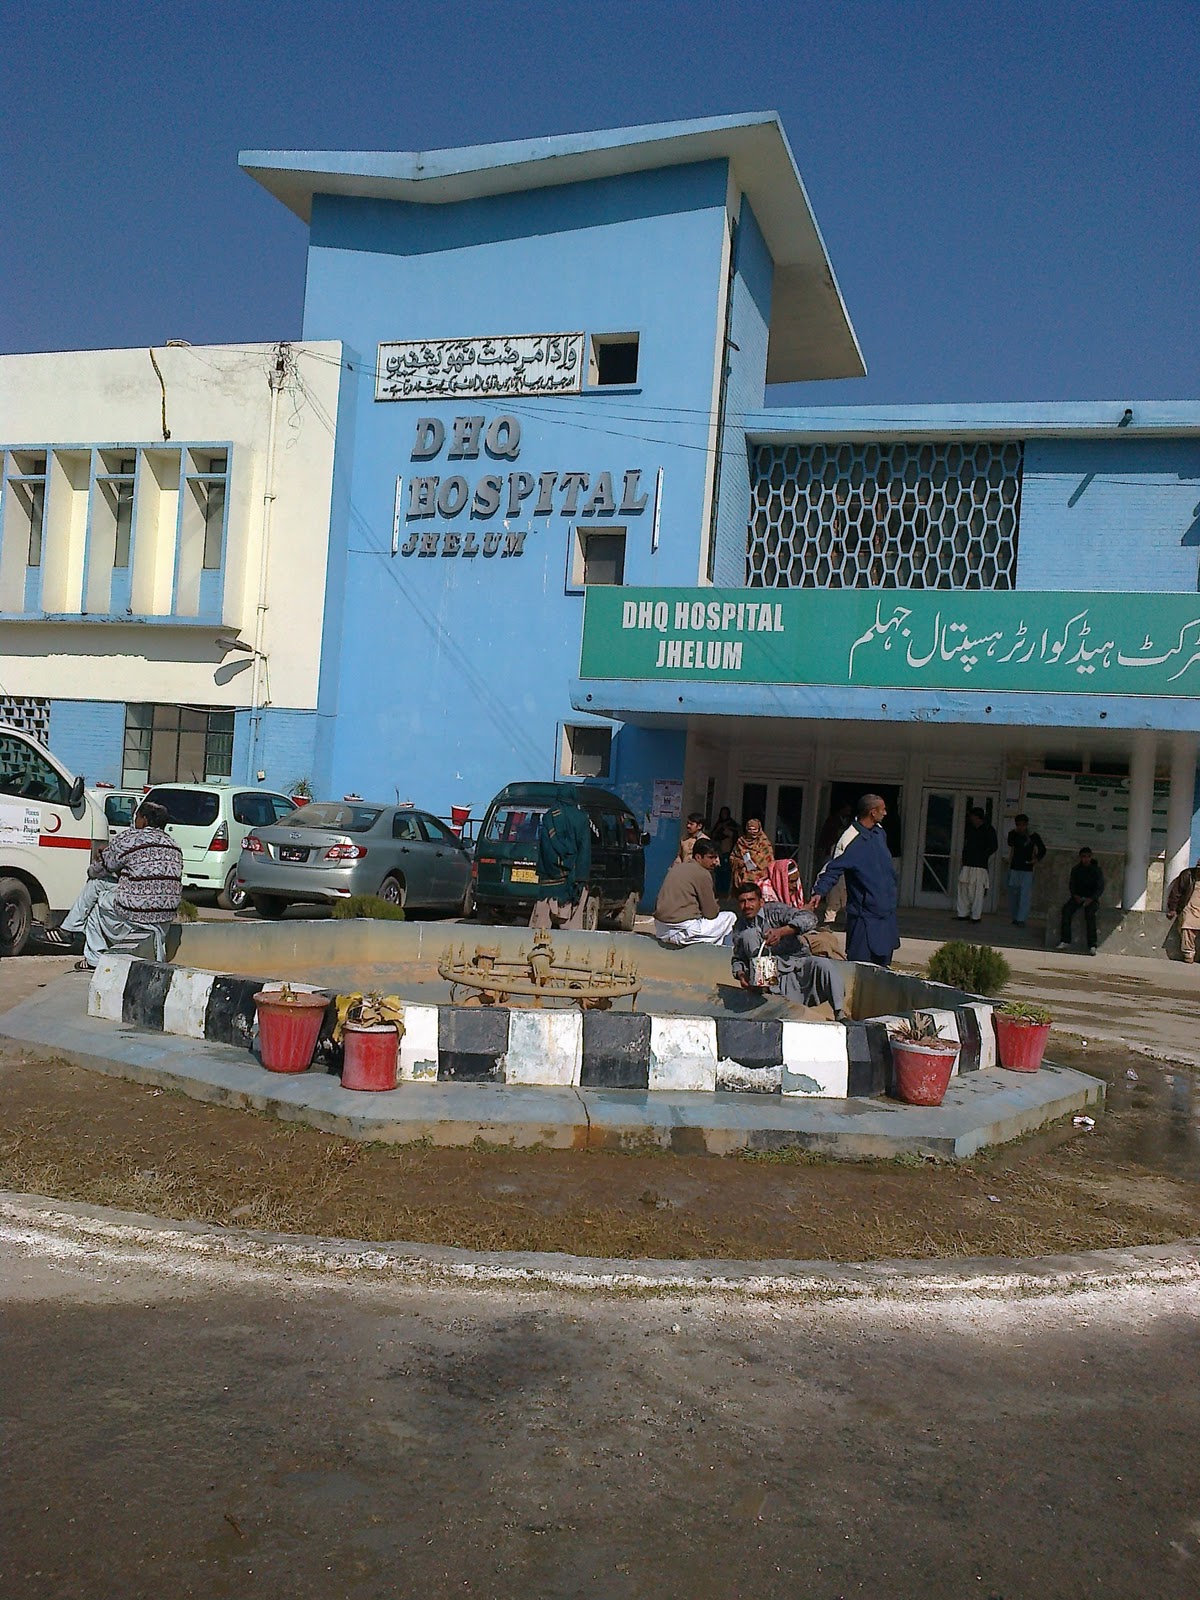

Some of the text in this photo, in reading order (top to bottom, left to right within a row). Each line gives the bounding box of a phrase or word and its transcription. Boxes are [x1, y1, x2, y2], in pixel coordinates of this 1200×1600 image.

[410, 414, 521, 462] DHQ
[406, 469, 649, 521] HOSPITAL
[401, 531, 527, 558] JHELUM
[622, 601, 785, 633] DHQ HOSPITAL
[847, 598, 913, 680] جہلم
[656, 640, 743, 670] JHELUM
[905, 610, 1004, 673] ہسپتال
